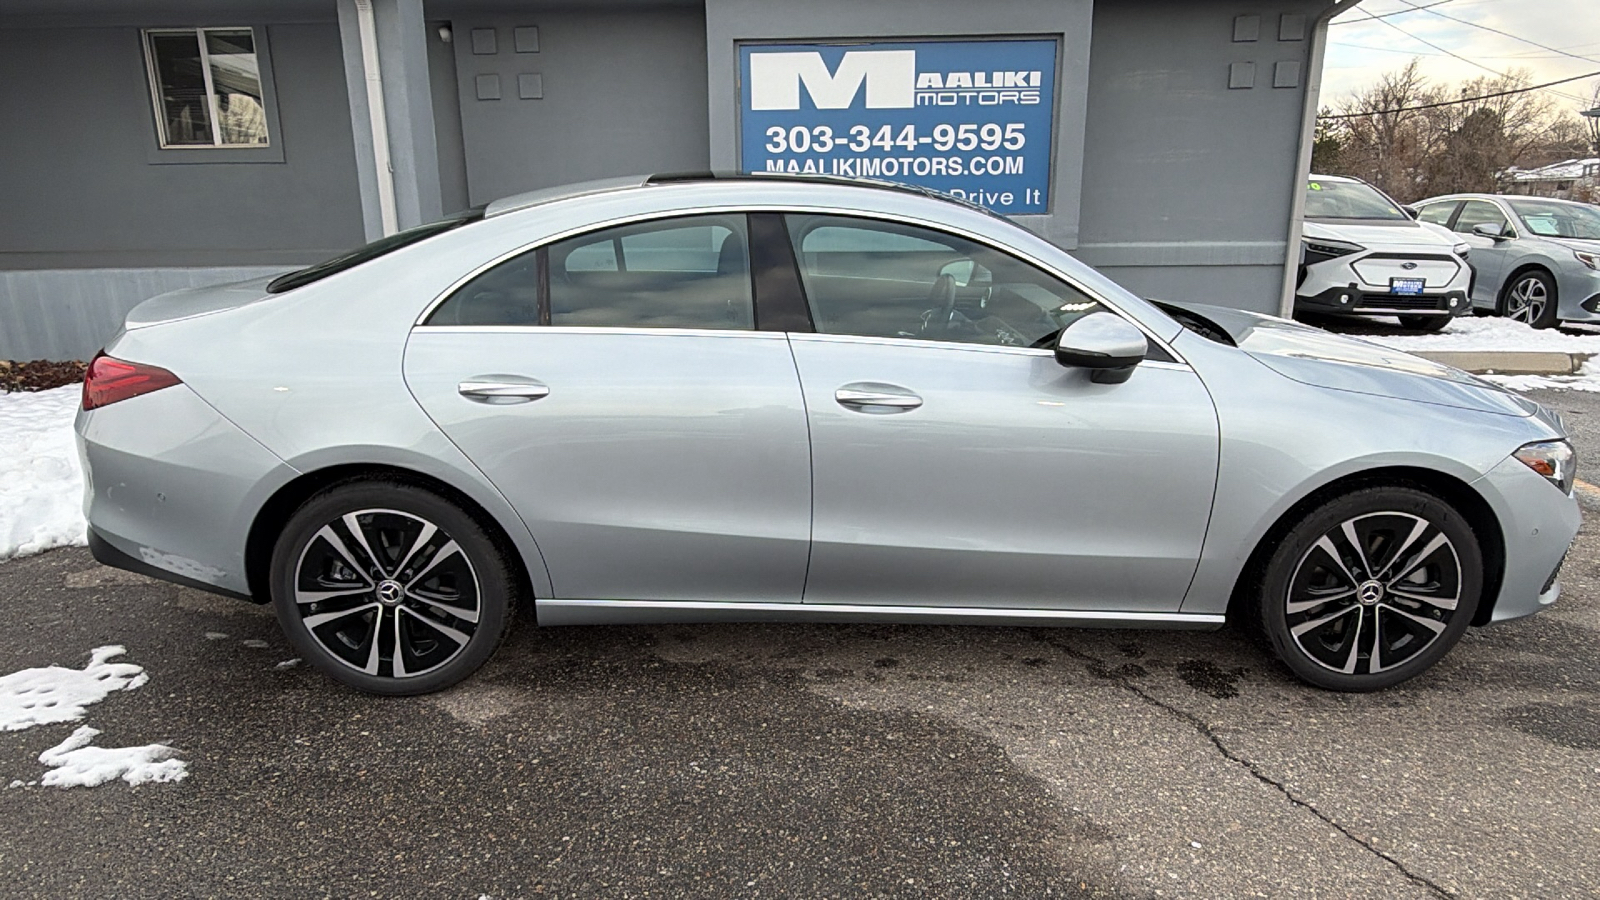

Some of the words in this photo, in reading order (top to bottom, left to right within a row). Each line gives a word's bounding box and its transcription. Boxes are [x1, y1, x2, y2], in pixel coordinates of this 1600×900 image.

[917, 91, 1041, 106] MOTORS
[765, 123, 1026, 154] 303-344-9595
[766, 156, 1024, 176] MAALIKIMOTORS.COM
[1026, 188, 1041, 205] It
